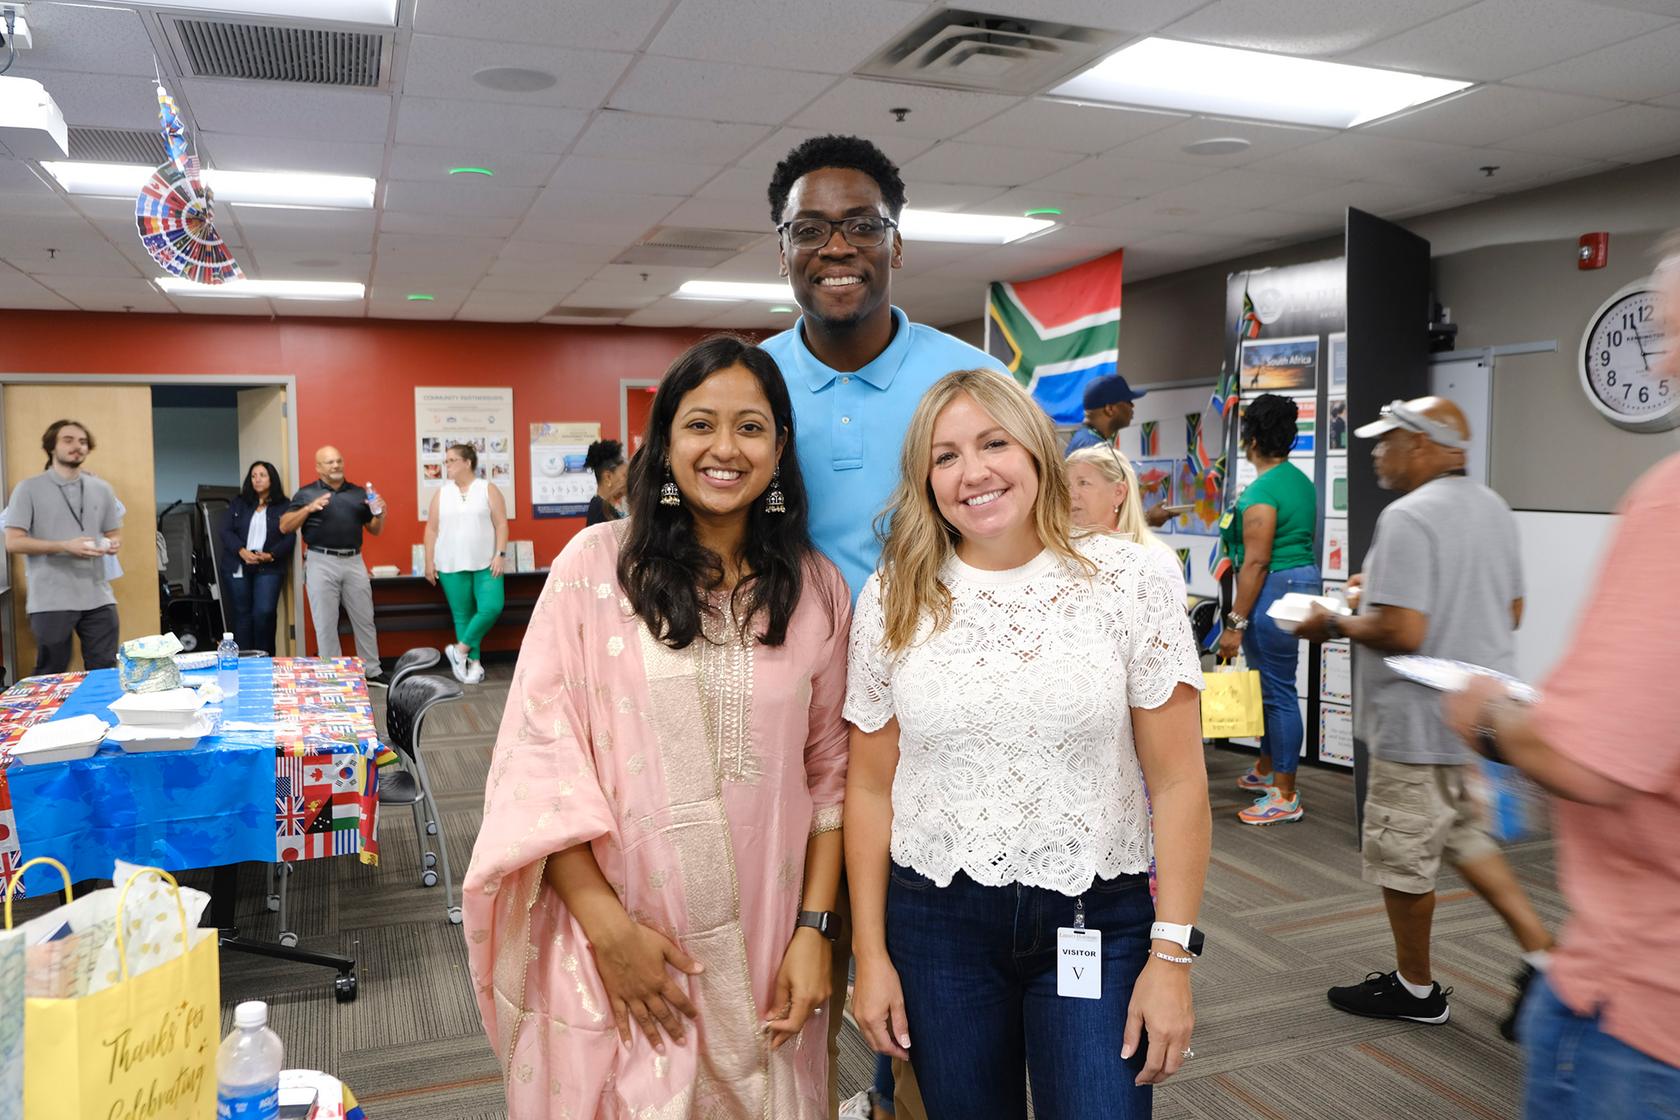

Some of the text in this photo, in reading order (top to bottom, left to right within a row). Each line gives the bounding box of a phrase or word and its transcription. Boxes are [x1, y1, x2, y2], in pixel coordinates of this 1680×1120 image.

[1622, 312, 1635, 330] 11
[1638, 305, 1654, 322] 12
[1607, 330, 1622, 348] 10
[1266, 355, 1312, 367] South Africa
[1600, 350, 1611, 367] 9
[1606, 370, 1617, 387] 8
[1622, 383, 1633, 400] 7
[1638, 386, 1650, 403] 6
[1658, 379, 1670, 397] 5
[1062, 949, 1096, 957] VISITOR
[1072, 966, 1084, 980] V
[102, 1003, 206, 1085] Thanks for
